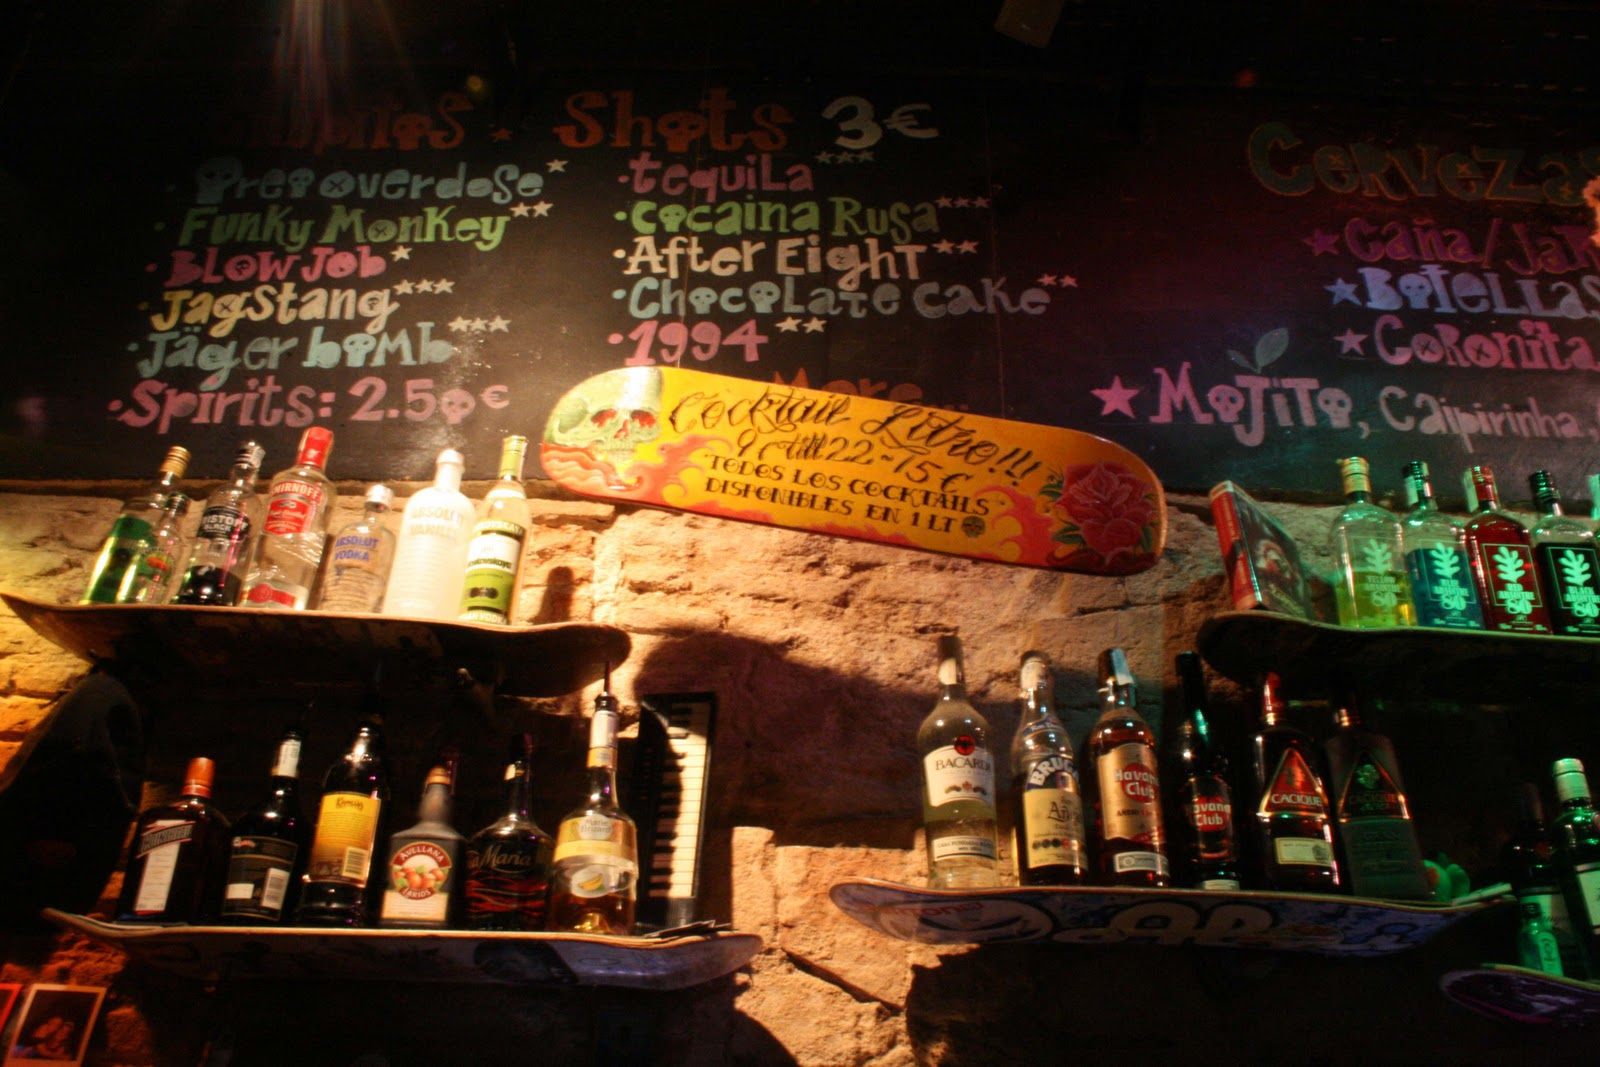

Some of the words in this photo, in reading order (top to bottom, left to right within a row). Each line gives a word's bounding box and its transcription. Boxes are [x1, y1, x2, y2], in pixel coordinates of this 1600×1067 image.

[552, 87, 797, 153] Shots
[822, 95, 939, 149] 3€
[631, 199, 820, 236] Cocaina
[828, 196, 940, 244] Rusa
[624, 235, 765, 278] After
[625, 319, 769, 367] 1994
[669, 385, 851, 434] Cocktail
[860, 403, 1043, 487] Litro!!!
[271, 482, 320, 500] MIRNOFF
[709, 454, 785, 481] TODOS
[793, 468, 841, 492] LOS
[849, 477, 990, 516] COCKTAILS
[705, 477, 853, 516] DISPONIBLES
[866, 504, 900, 524] EN
[911, 511, 920, 527] 1
[928, 514, 958, 533] LT
[335, 535, 380, 549] ABSOLUT
[335, 549, 370, 561] VODKA
[1504, 582, 1524, 592] RED
[936, 756, 991, 771] BACARDI
[1125, 781, 1156, 799] Club
[1270, 793, 1323, 807] CACIQUE
[1195, 812, 1225, 827] Club
[400, 845, 445, 863] AVELLANA
[402, 887, 432, 898] LARIOS
